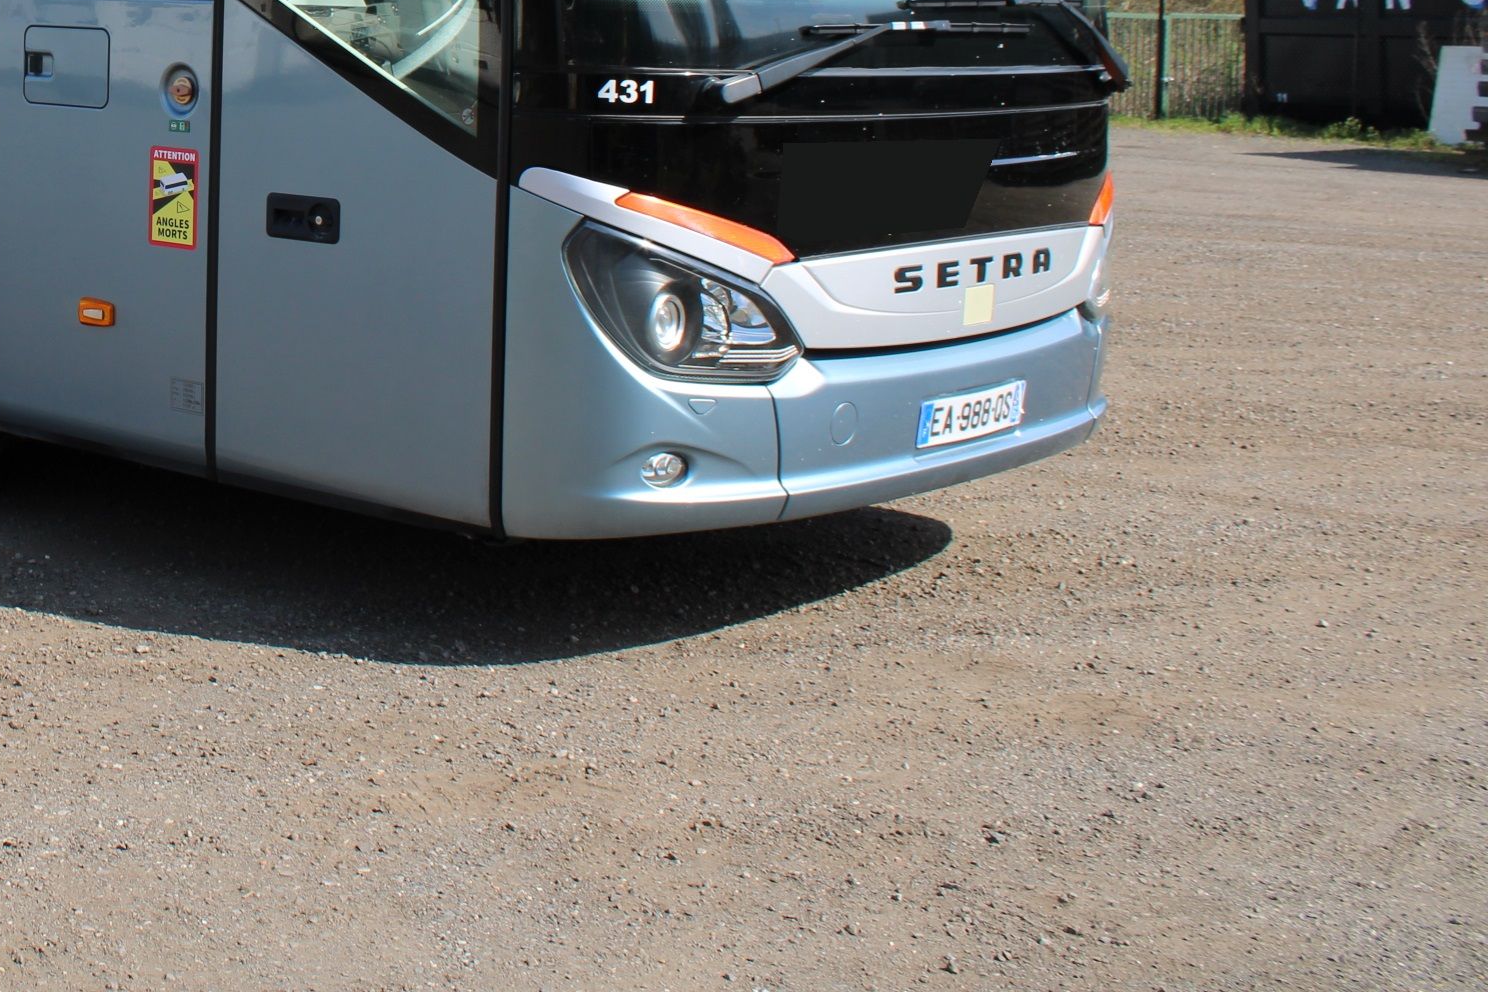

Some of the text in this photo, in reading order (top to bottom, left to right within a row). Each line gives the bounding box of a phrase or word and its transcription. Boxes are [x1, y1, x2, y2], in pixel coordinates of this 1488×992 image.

[597, 78, 654, 104] 431
[153, 149, 196, 162] ATTENTION
[156, 216, 190, 229] ANGLES
[157, 227, 188, 240] MORTS
[894, 247, 1051, 294] SETRA
